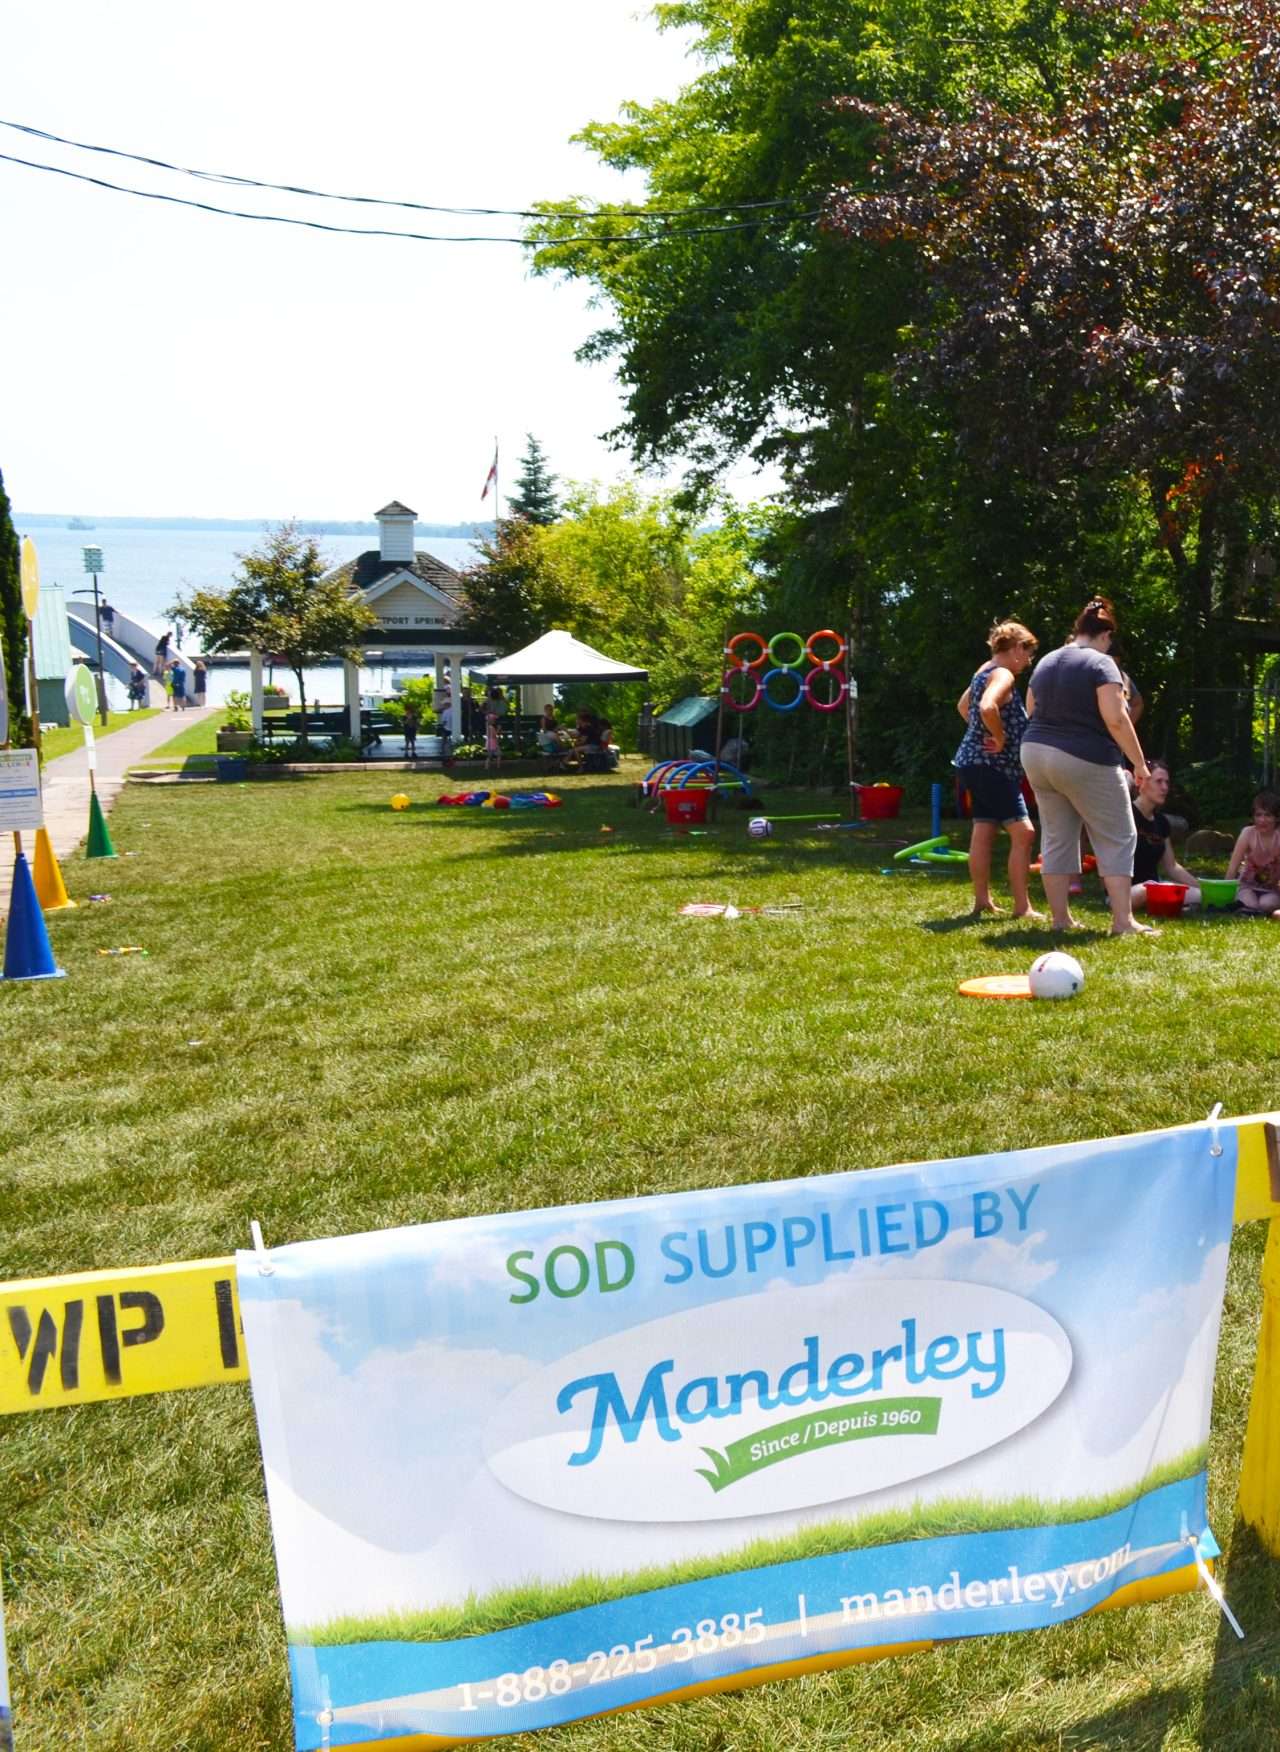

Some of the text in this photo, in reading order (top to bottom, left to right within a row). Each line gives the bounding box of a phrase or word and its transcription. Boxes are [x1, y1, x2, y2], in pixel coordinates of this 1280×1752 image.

[506, 1183, 1040, 1305] SOD SUPPLIED BY
[7, 1291, 165, 1396] WP
[556, 1318, 1005, 1466] Manderley
[750, 1431, 800, 1461] Since
[814, 1410, 877, 1438] Depuis
[880, 1410, 921, 1427] 1960
[456, 1542, 1132, 1712] 1-888-225-3885 manderley.com
